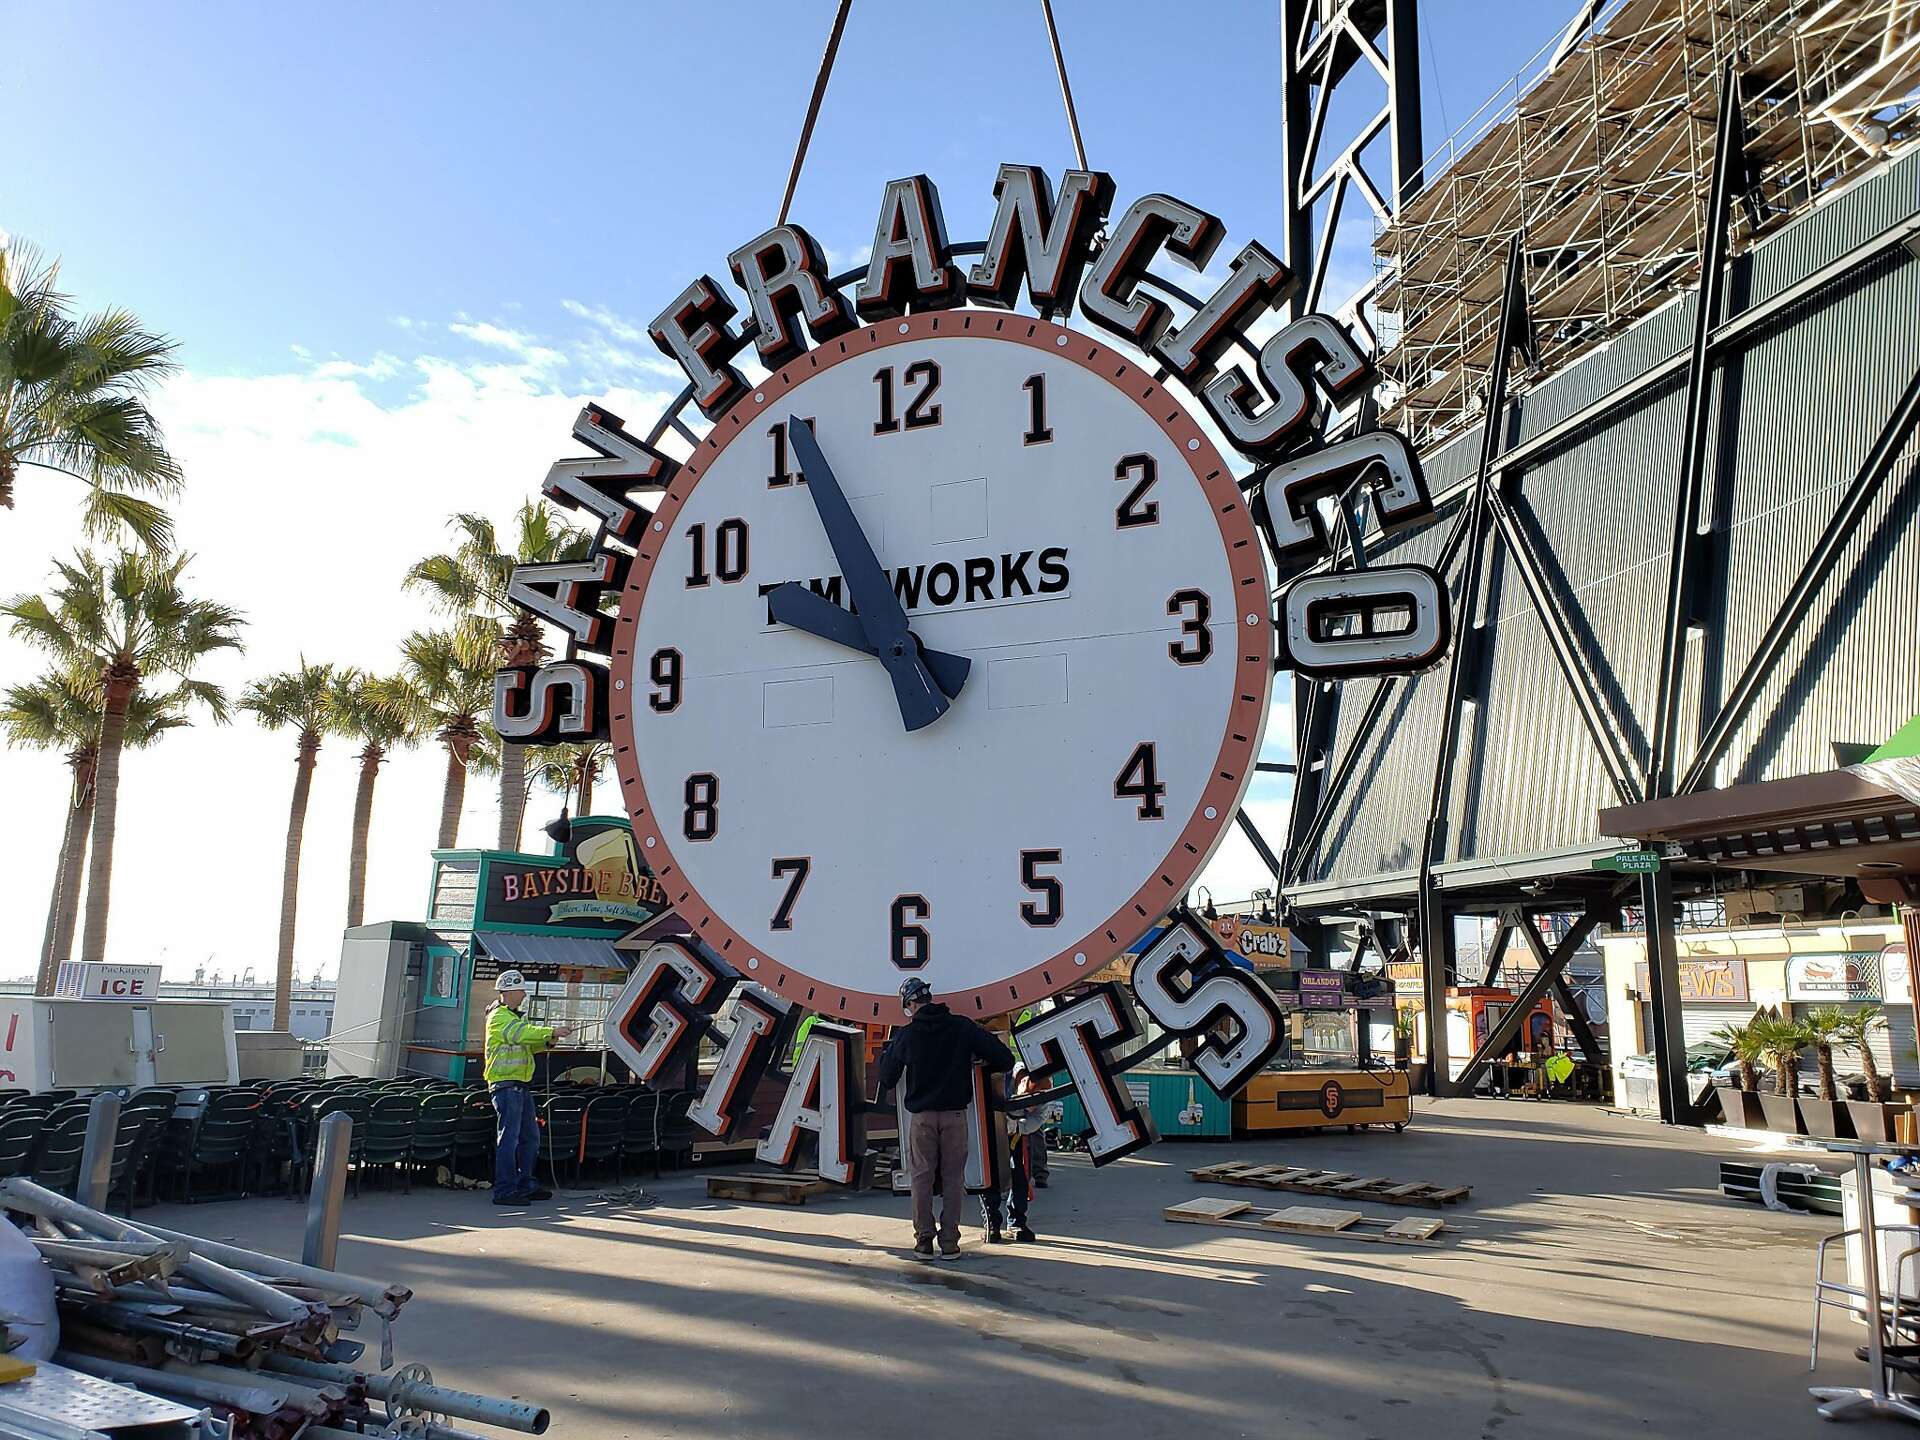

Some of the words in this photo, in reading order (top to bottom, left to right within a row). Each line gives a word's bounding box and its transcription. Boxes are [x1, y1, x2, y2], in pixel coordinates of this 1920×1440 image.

[873, 359, 942, 436] 12
[1022, 373, 1054, 446] 1
[494, 403, 672, 742] SAN
[648, 165, 1448, 676] FRANCISCO
[767, 416, 816, 489] 1
[1114, 451, 1160, 529] 2
[684, 517, 749, 589] 10
[758, 548, 1070, 625] TMWORKS
[1166, 588, 1214, 666] 3
[648, 647, 683, 714] 9
[684, 772, 719, 842] 8
[1113, 742, 1166, 821] 4
[504, 868, 613, 901] BAYSIDE
[619, 872, 672, 905] BRE
[770, 857, 811, 931] 7
[1020, 848, 1063, 928] 5
[1640, 854, 1657, 862] ALE
[890, 894, 930, 971] 6
[1240, 930, 1288, 957] Crab'z
[101, 966, 150, 976] Packaged
[101, 979, 144, 995] ICE
[1302, 976, 1341, 986] ORLANDO'S
[1387, 964, 1423, 980] LAGUNIT
